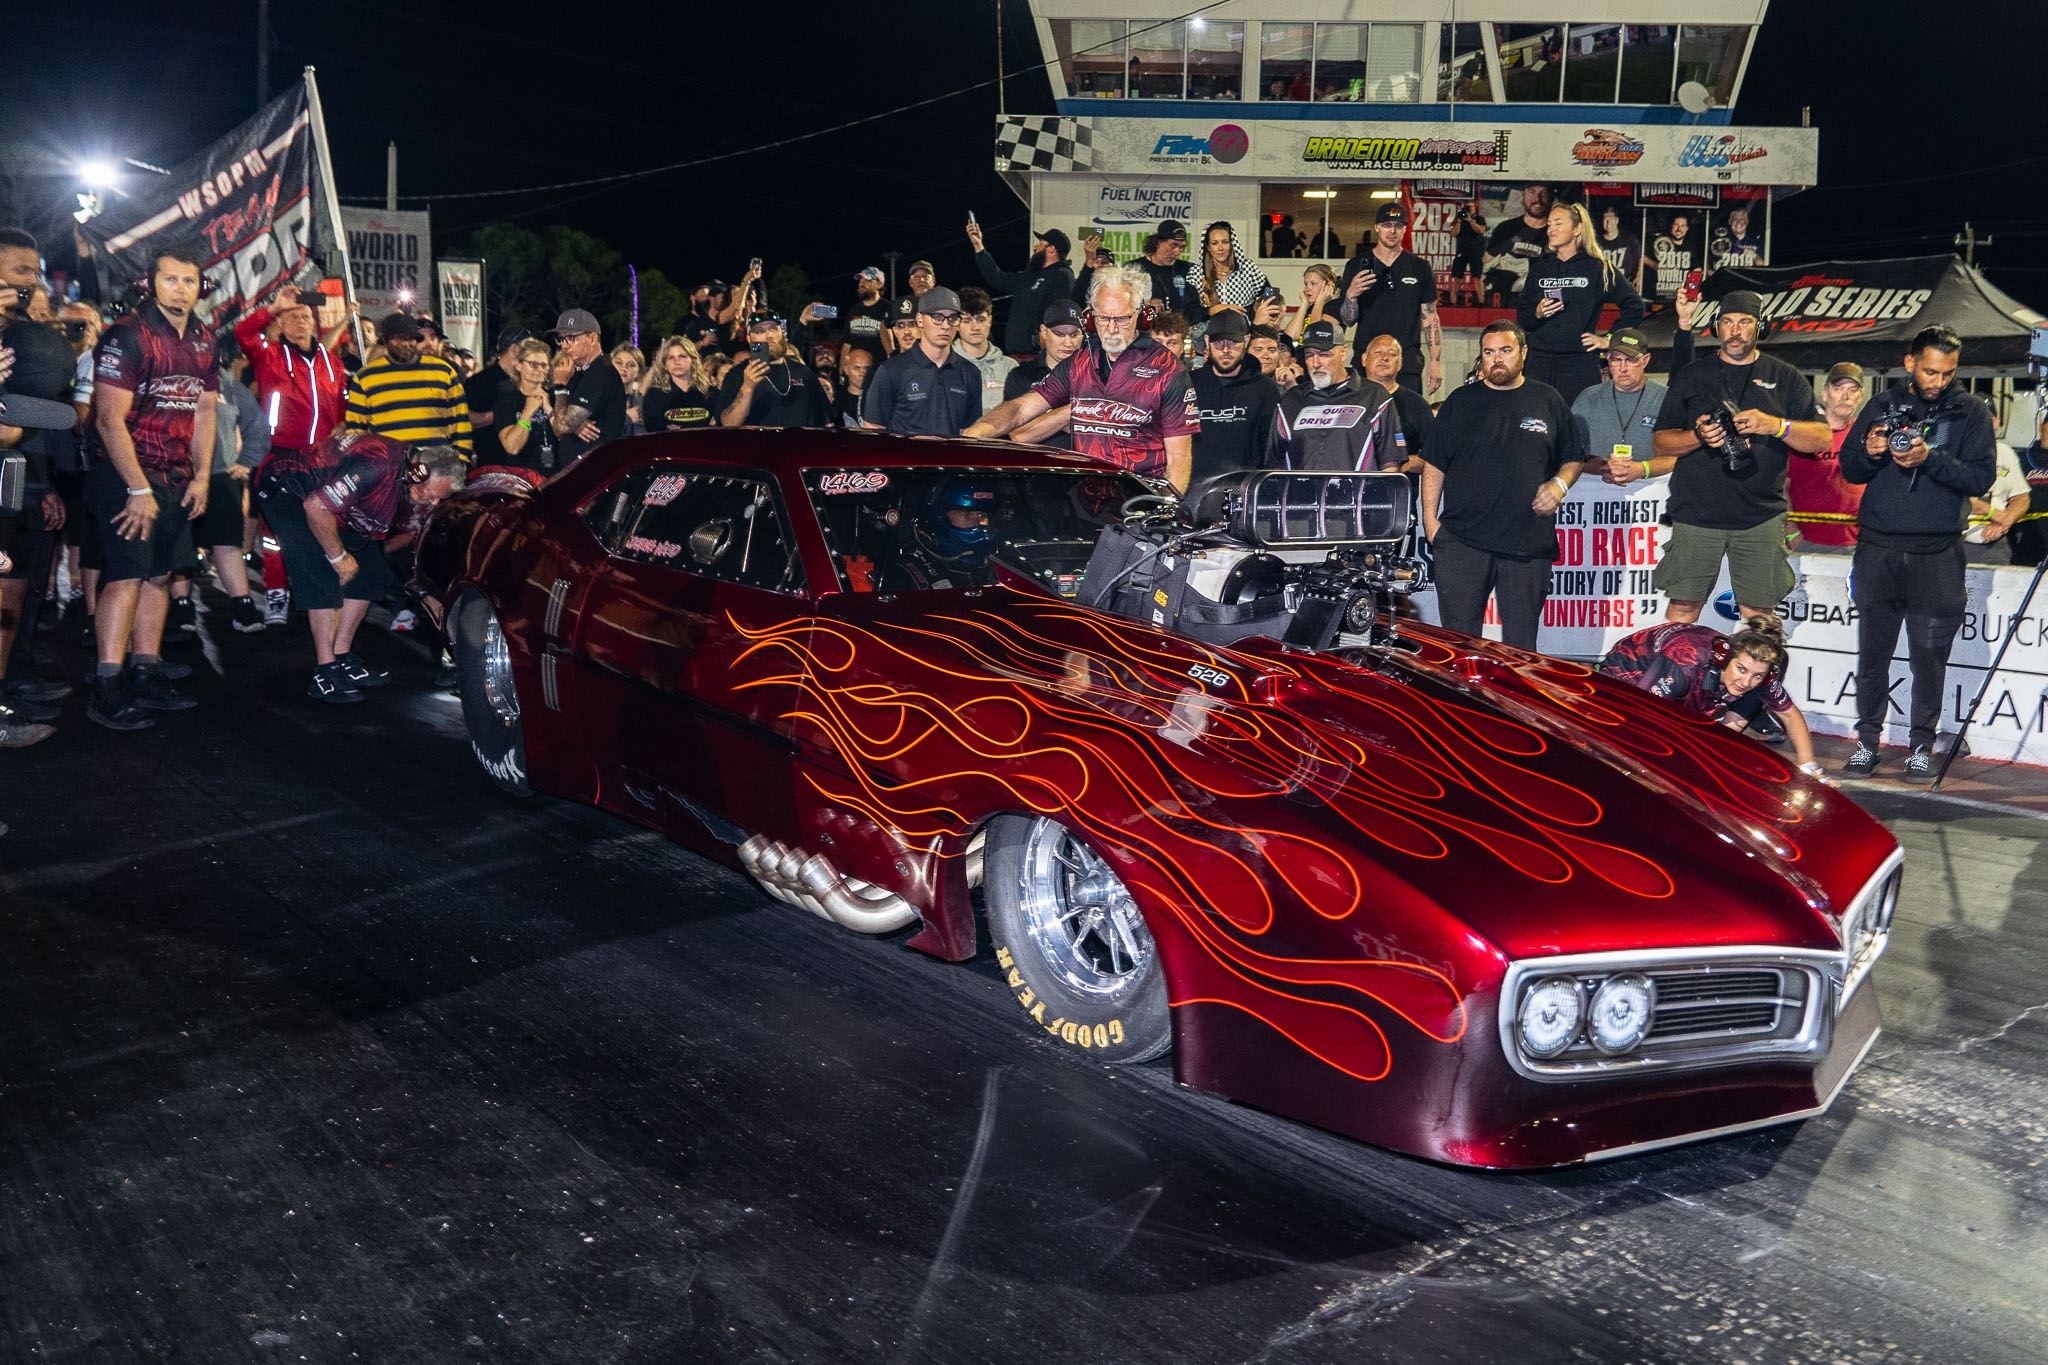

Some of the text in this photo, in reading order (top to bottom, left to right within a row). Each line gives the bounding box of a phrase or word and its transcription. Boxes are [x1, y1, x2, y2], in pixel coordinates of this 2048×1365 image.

[1303, 137, 1420, 161] BRADENTON
[1328, 160, 1463, 171] www.RACEBMP.com
[1461, 155, 1496, 165] PARK
[178, 148, 268, 220] WSOPM
[1641, 183, 1713, 200] WORLD SERIES
[1101, 187, 1192, 203] FUEL INJECTOR
[1146, 203, 1192, 219] CLINIC
[1413, 202, 1457, 232] 202
[348, 231, 418, 262] WORLD
[1104, 231, 1132, 253] ATA
[1411, 232, 1457, 255] WOR
[1658, 250, 1691, 269] 2018
[1721, 252, 1754, 267] 2019
[351, 262, 418, 291] SERIES
[1657, 269, 1688, 282] WORL
[443, 282, 479, 301] WORLD
[1656, 282, 1682, 291] CHAMP
[444, 300, 480, 318] SERIES
[1692, 286, 1933, 328] WLD SERIES
[1781, 319, 1877, 333] MOD
[1322, 407, 1357, 415] QUICK
[1299, 417, 1334, 425] DRIVE
[1074, 424, 1132, 438] RACING
[820, 472, 888, 491] 1469
[1555, 500, 1659, 528] EST, RICHEST
[1552, 527, 1658, 567] OD RACE
[1547, 570, 1597, 595] STORY
[1602, 570, 1622, 595] OF
[1543, 599, 1635, 628] UNIVERSE
[1774, 601, 1860, 626] SUBAR
[1187, 663, 1231, 687] 526
[996, 946, 1125, 1049] GOODYEAR
